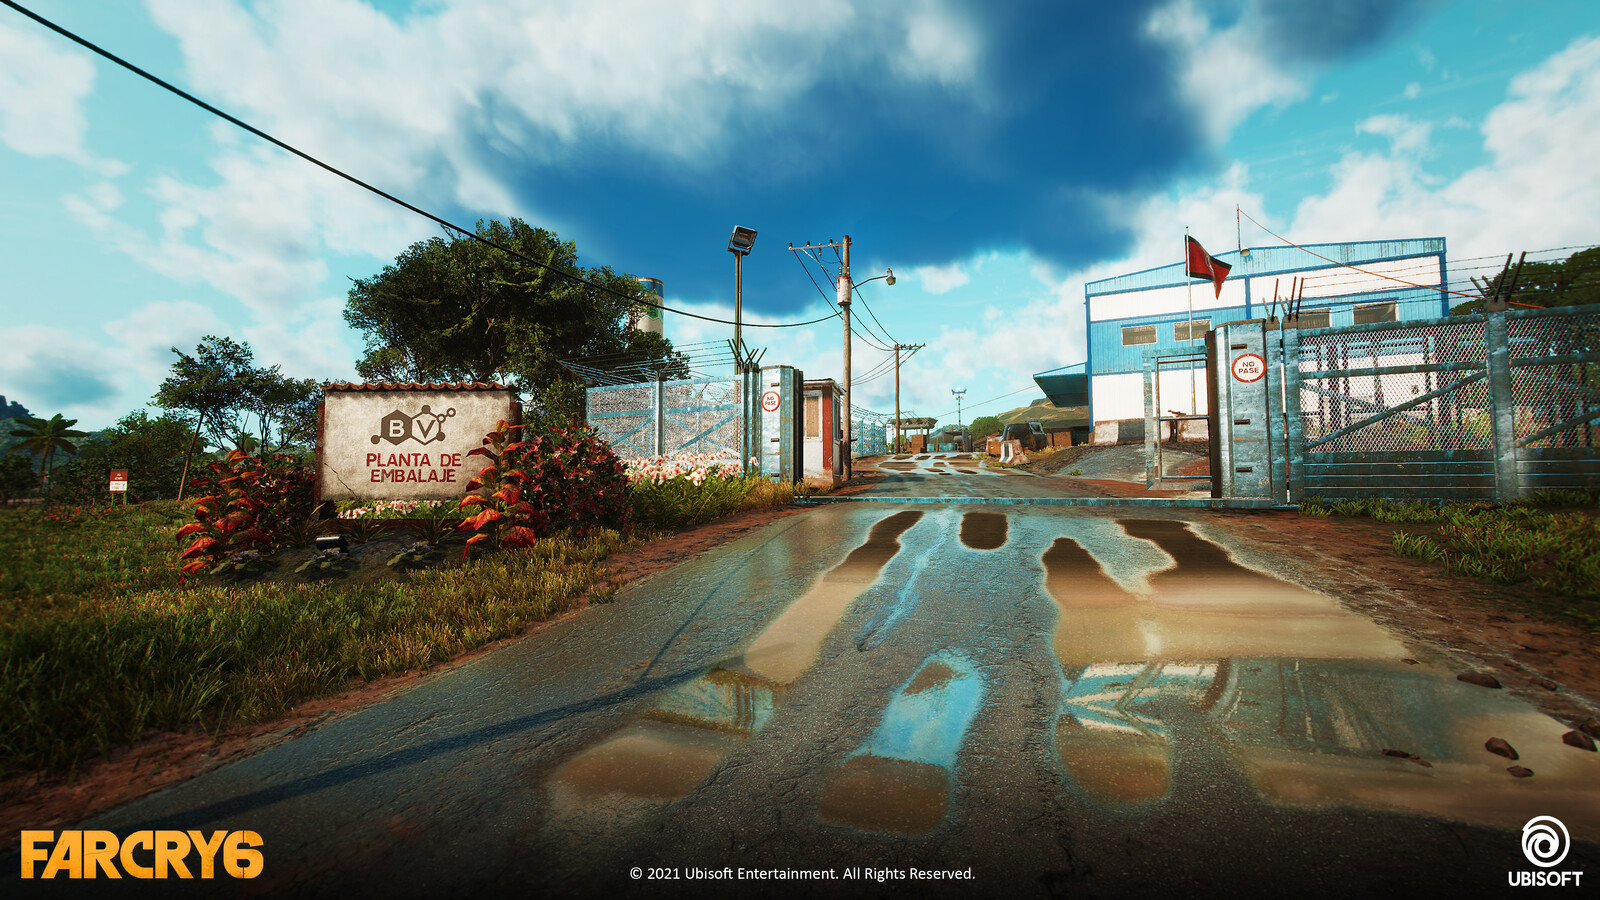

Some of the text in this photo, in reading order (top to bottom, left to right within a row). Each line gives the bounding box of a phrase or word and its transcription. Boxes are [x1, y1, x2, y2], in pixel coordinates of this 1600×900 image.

[366, 453, 462, 467] PLANTA DE
[370, 469, 457, 483] EMBALAJE
